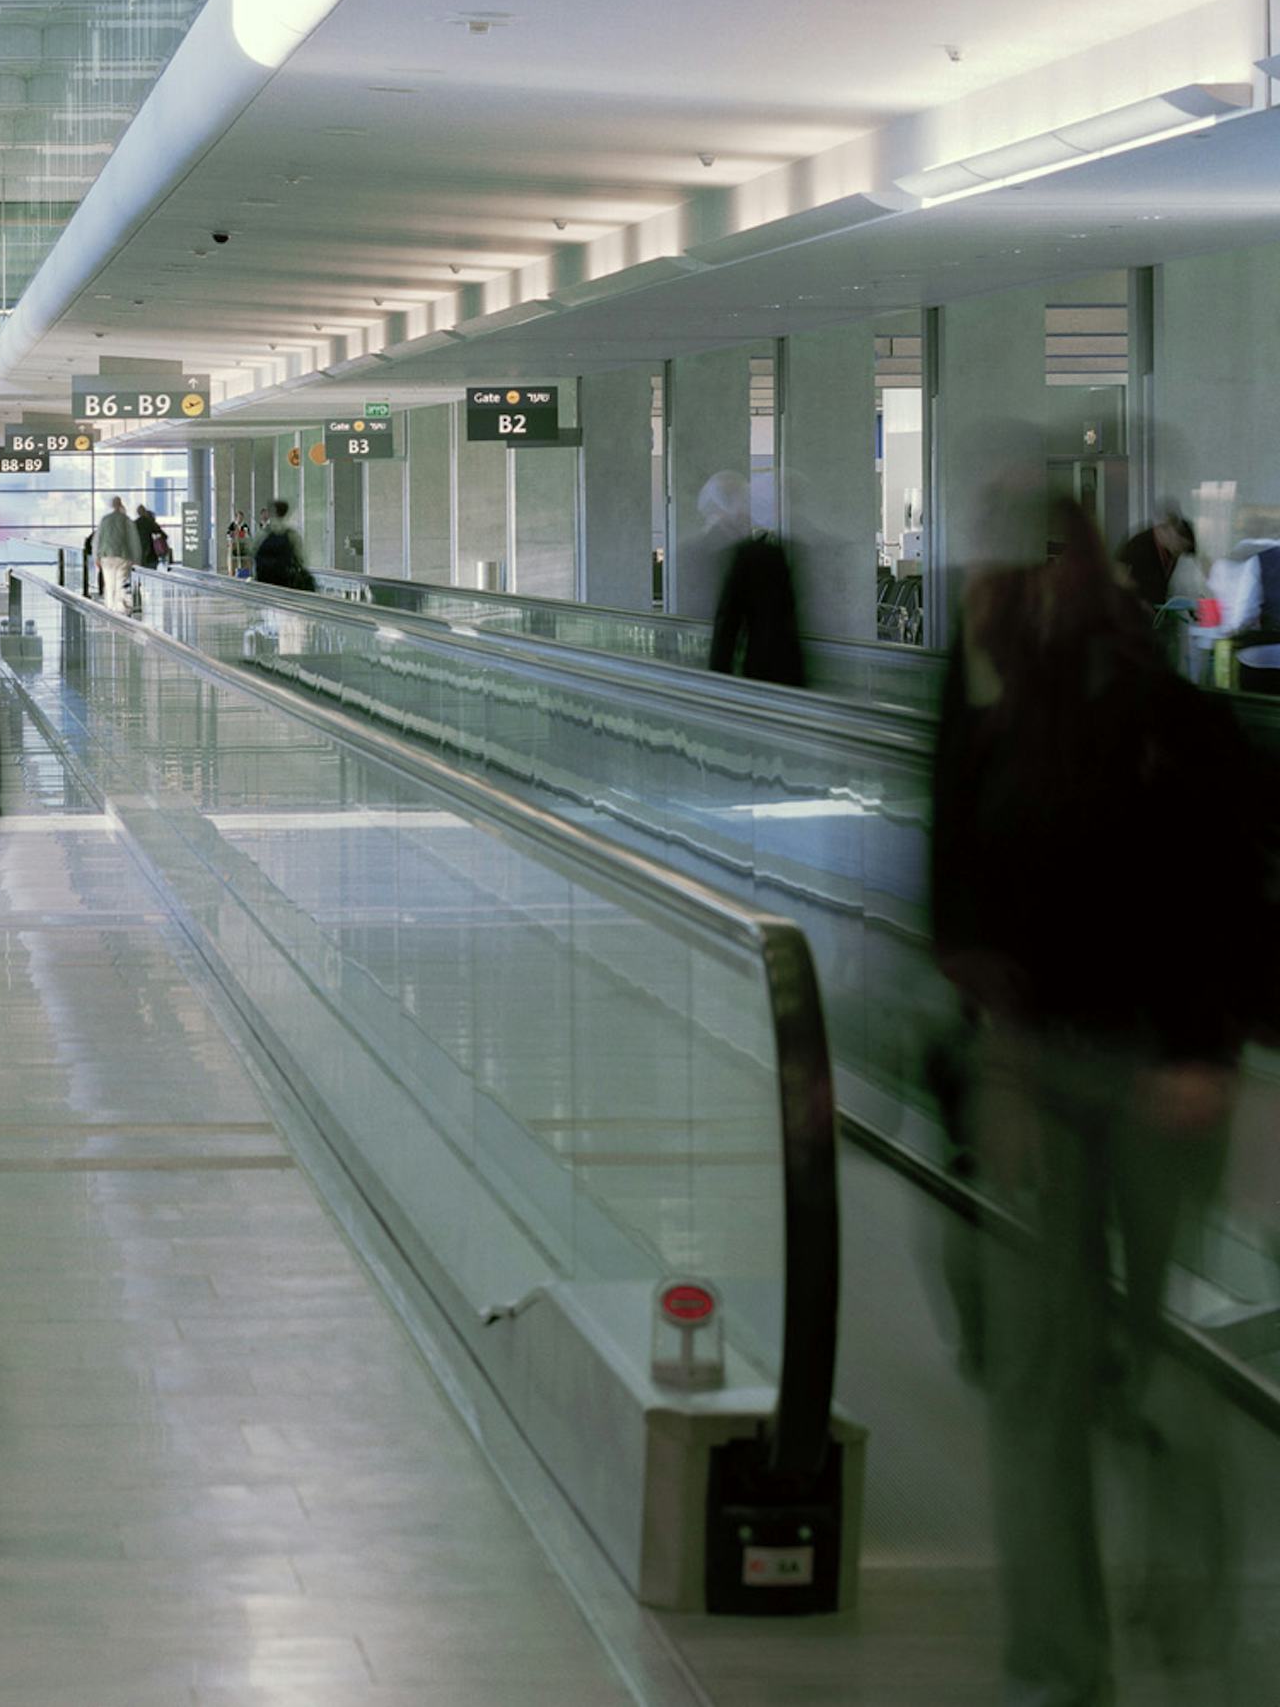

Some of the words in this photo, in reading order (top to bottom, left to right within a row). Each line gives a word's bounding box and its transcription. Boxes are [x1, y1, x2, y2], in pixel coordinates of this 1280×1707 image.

[473, 391, 501, 404] Gate
[526, 392, 551, 403] שער
[84, 394, 118, 417] B6
[138, 394, 171, 417] B9
[330, 421, 350, 431] Gate
[498, 414, 527, 434] B2
[12, 436, 35, 451] B6
[47, 436, 69, 451] B9
[348, 438, 370, 454] B3
[1, 459, 43, 473] B8-B9
